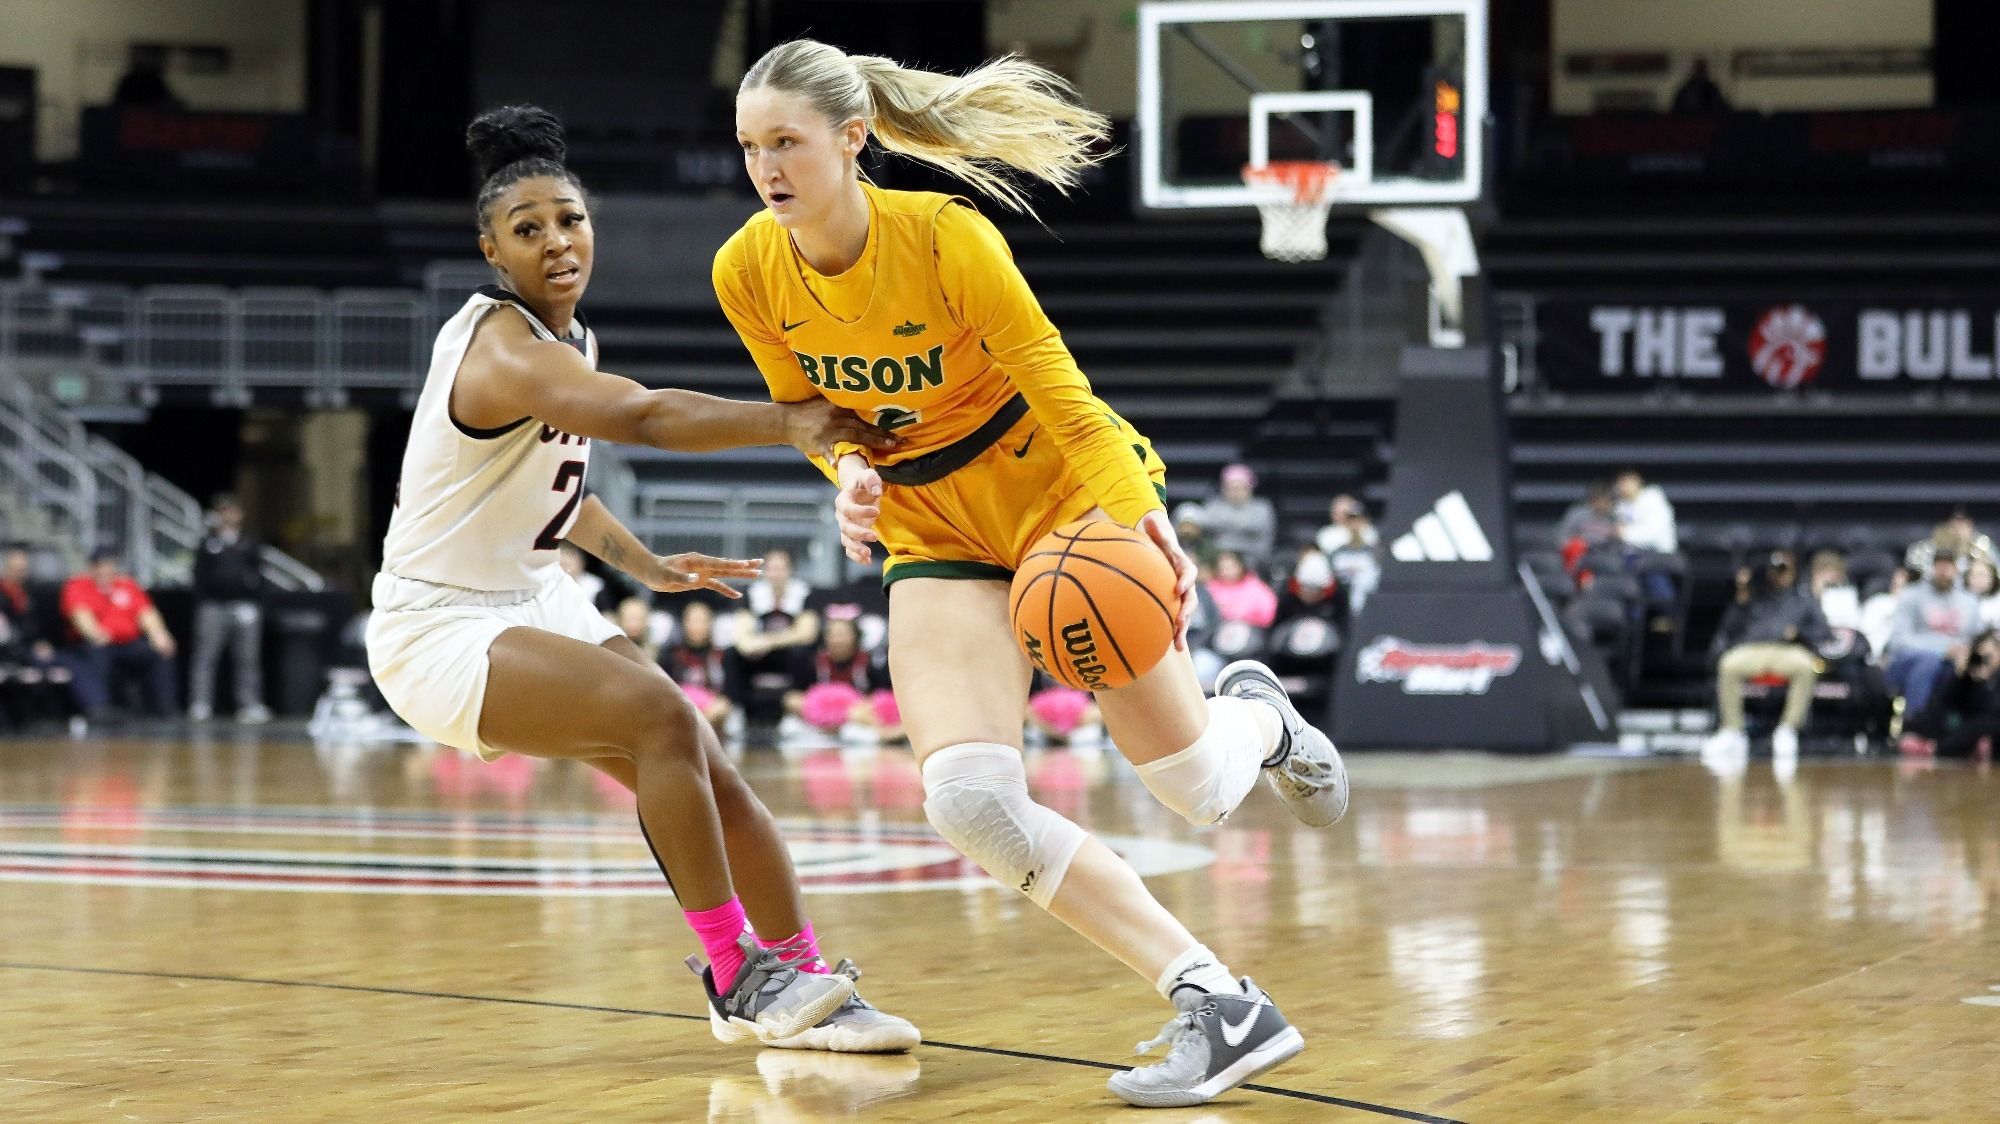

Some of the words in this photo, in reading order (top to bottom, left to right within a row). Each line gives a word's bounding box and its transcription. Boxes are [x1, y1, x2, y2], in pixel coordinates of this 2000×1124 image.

[792, 344, 945, 394] BISON
[1590, 308, 1725, 378] THE
[1856, 309, 2000, 381] BUL
[532, 459, 586, 550] 2
[1061, 617, 1112, 691] Wilso
